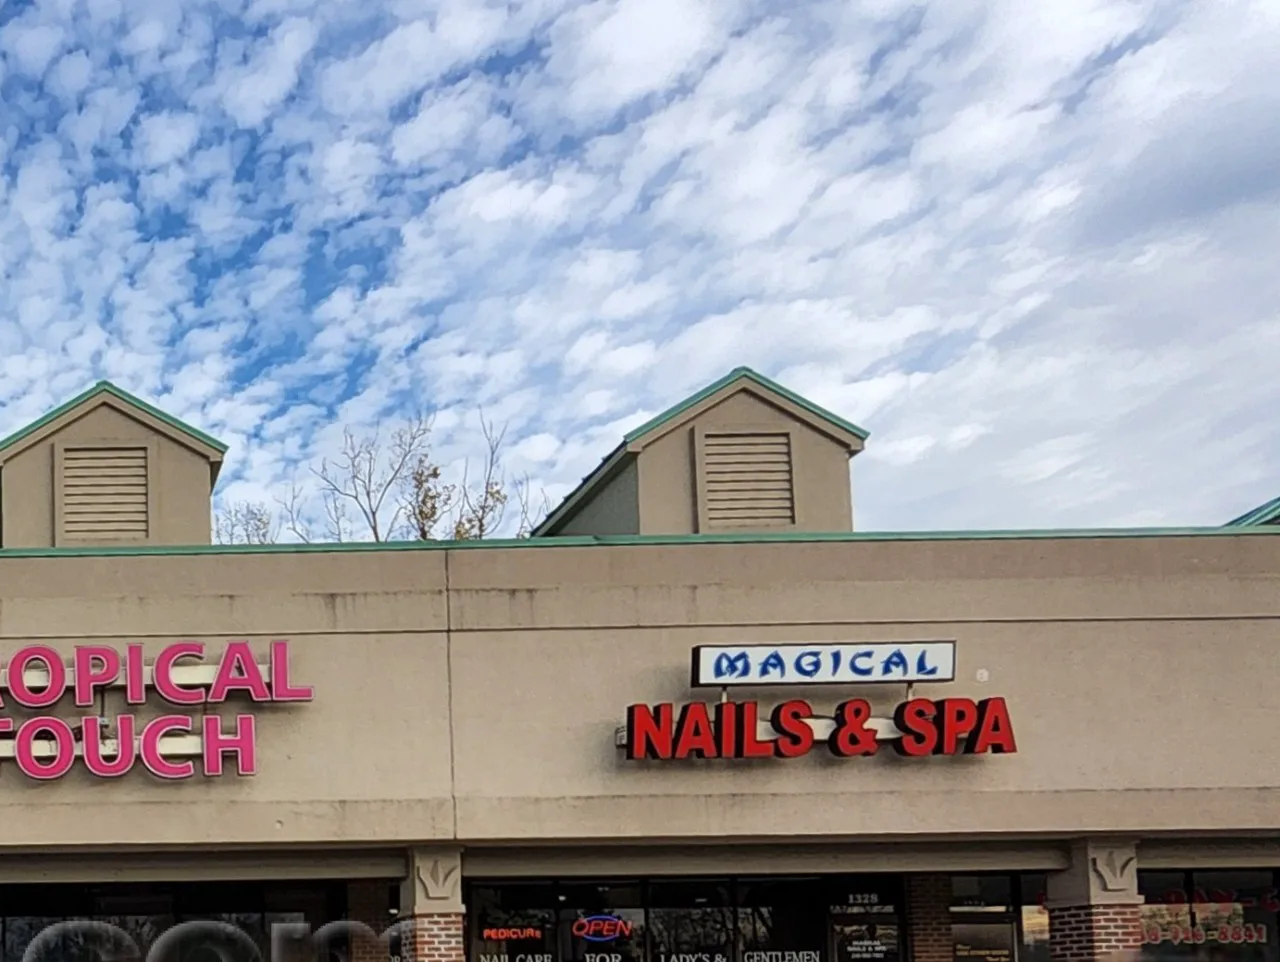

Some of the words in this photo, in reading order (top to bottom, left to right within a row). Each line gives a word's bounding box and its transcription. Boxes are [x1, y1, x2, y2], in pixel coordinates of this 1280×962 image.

[713, 649, 939, 679] MAGICAL
[627, 699, 814, 760] NAILS
[830, 698, 878, 757] &
[894, 697, 1018, 758] SPA
[572, 919, 633, 937] OPEN
